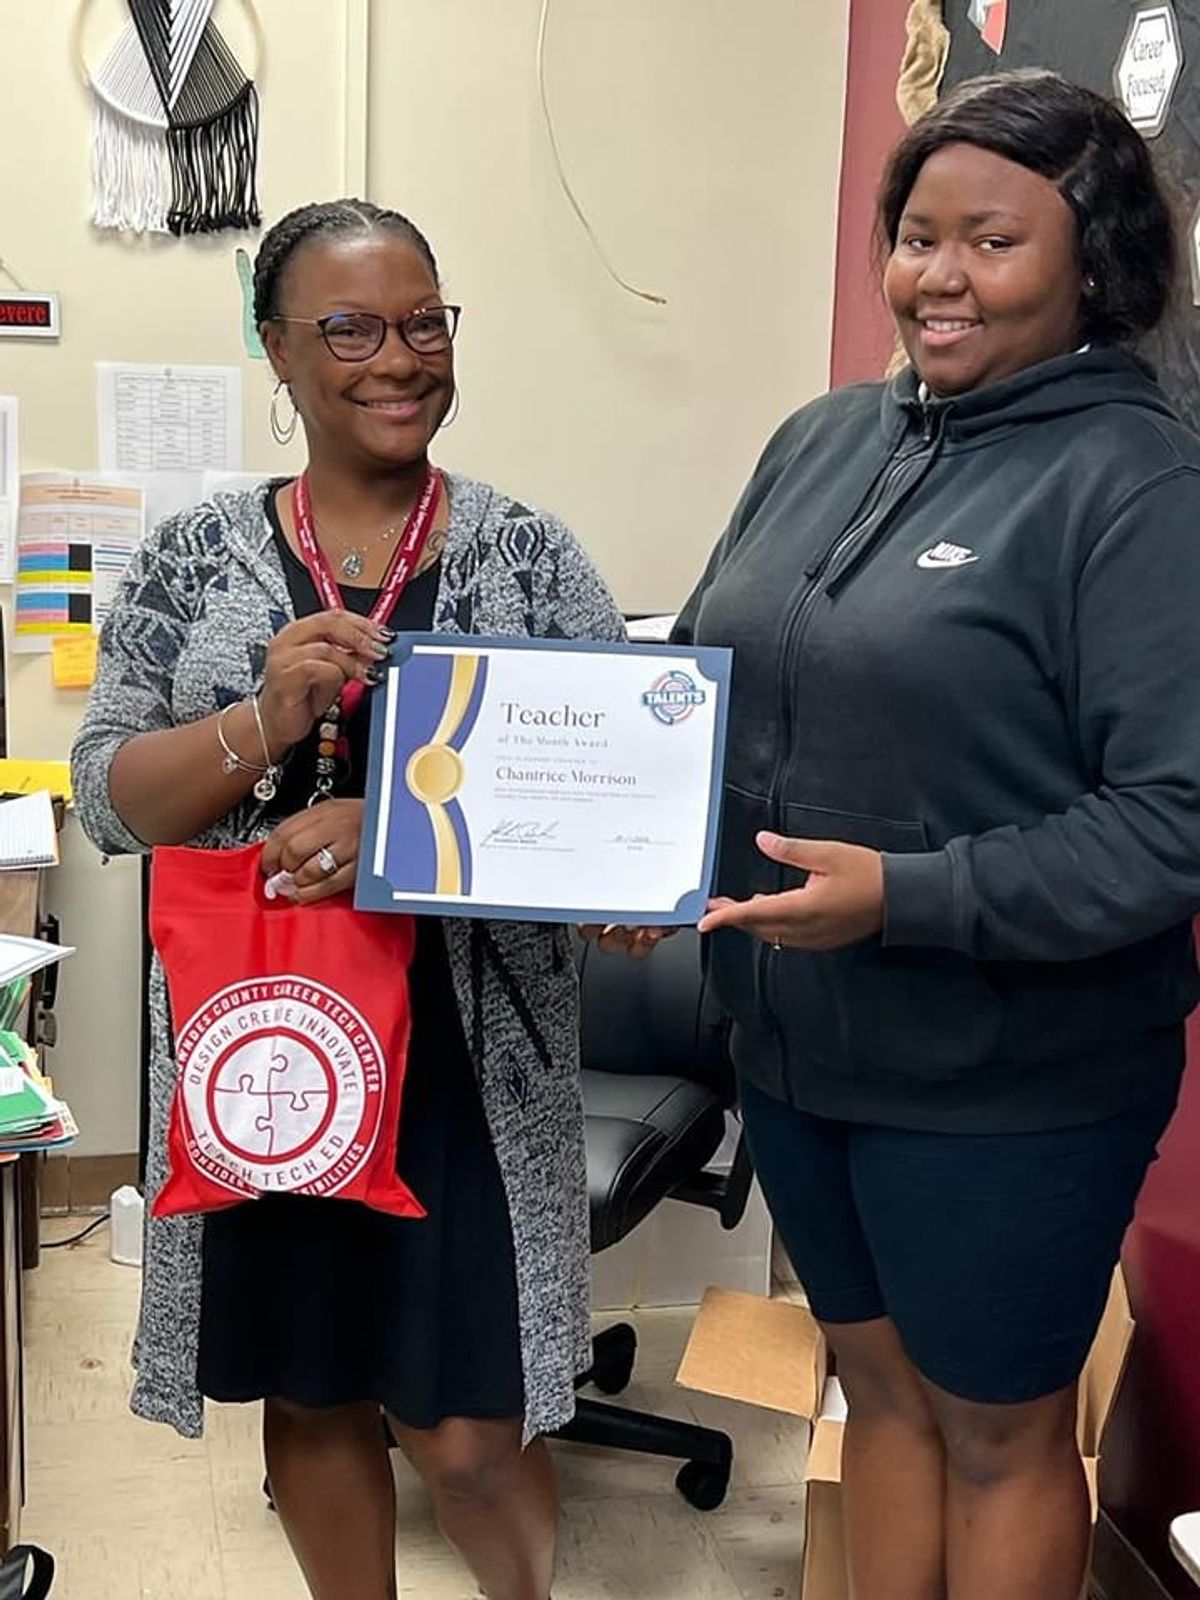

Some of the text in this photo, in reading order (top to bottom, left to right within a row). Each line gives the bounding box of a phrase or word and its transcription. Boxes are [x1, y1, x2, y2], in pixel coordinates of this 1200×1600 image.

[1132, 38, 1165, 62] Career
[1127, 69, 1166, 97] Focused
[500, 702, 606, 728] Teacher
[497, 735, 608, 748] of The Month Award
[495, 766, 637, 786] Chantrice Morrison
[188, 1024, 233, 1085] DESIGN
[298, 1012, 359, 1092] INNOVATE
[213, 984, 269, 1015] COUNTY
[323, 999, 359, 1032] TECH
[354, 1032, 381, 1093] CENTER
[188, 1139, 245, 1188] CONSIDER
[198, 1130, 345, 1186] TEACH TECH ED
